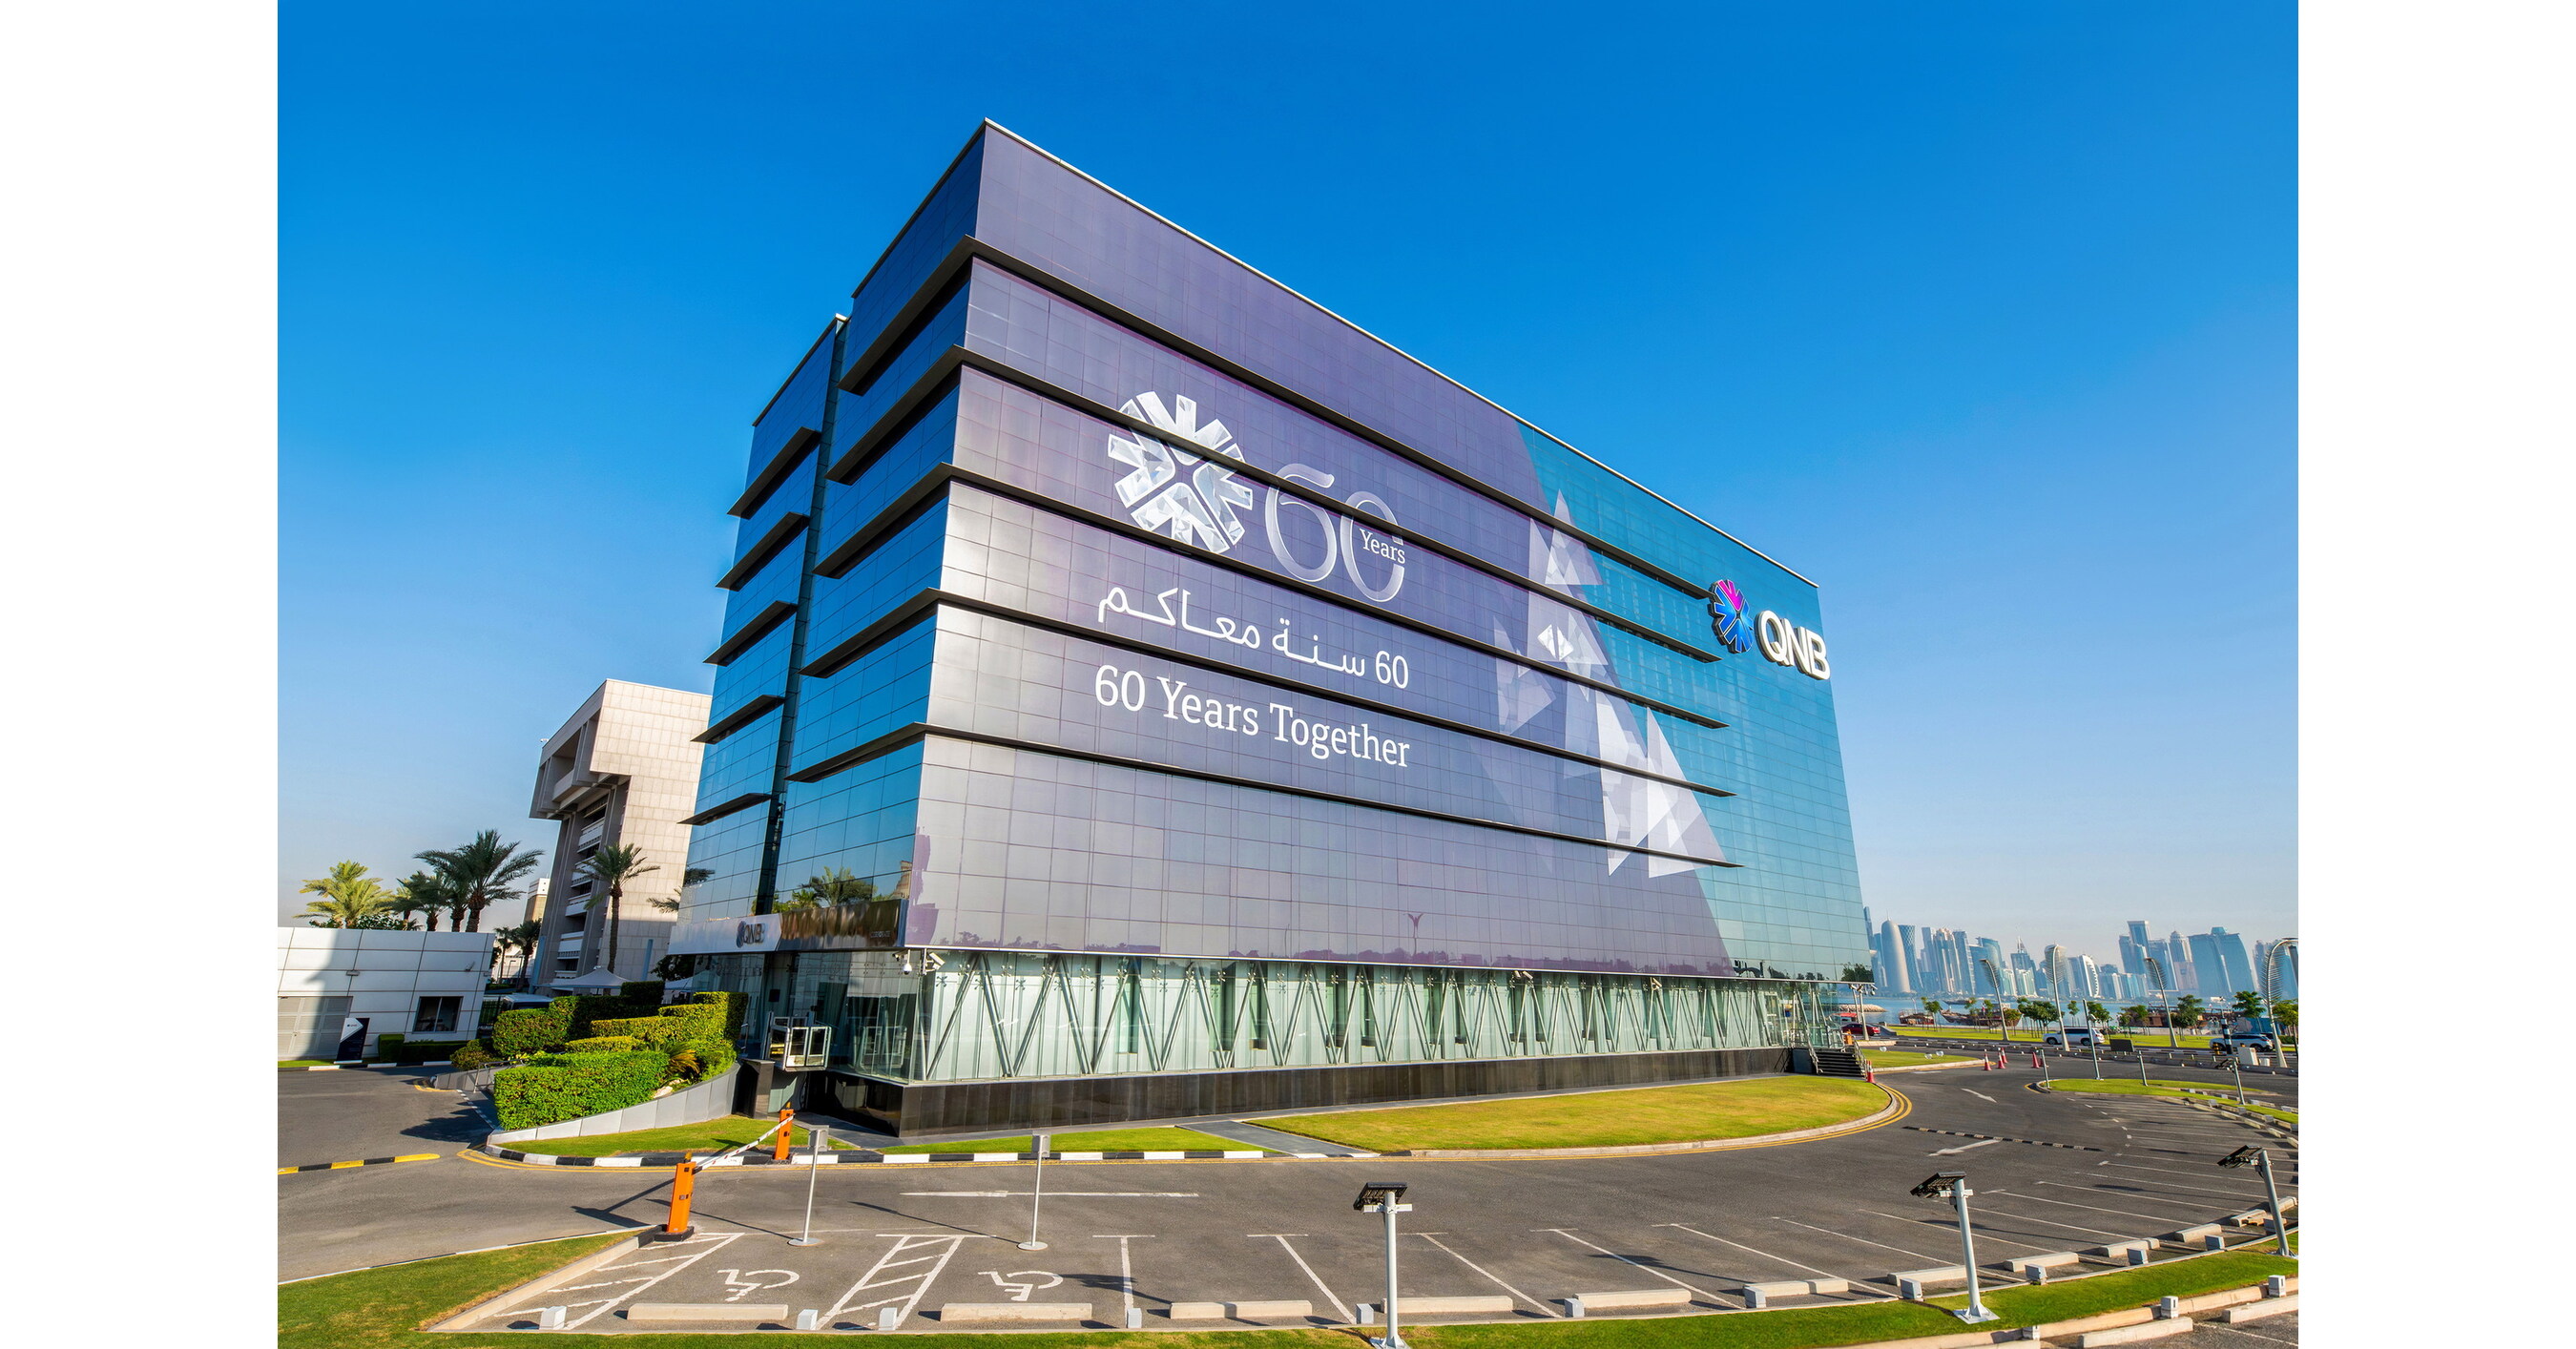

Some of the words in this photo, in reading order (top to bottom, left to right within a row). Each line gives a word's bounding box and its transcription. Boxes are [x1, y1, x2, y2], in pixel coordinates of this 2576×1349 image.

[1265, 464, 1404, 602] 60
[1359, 528, 1405, 564] Years
[1097, 586, 1261, 650] معاكم
[1272, 617, 1365, 677] سنة
[1754, 610, 1831, 680] QNB
[1375, 650, 1409, 689] 60
[1094, 664, 1146, 712] 60
[1155, 674, 1259, 737] Years
[1269, 702, 1410, 768] Together
[744, 923, 765, 944] QNB
